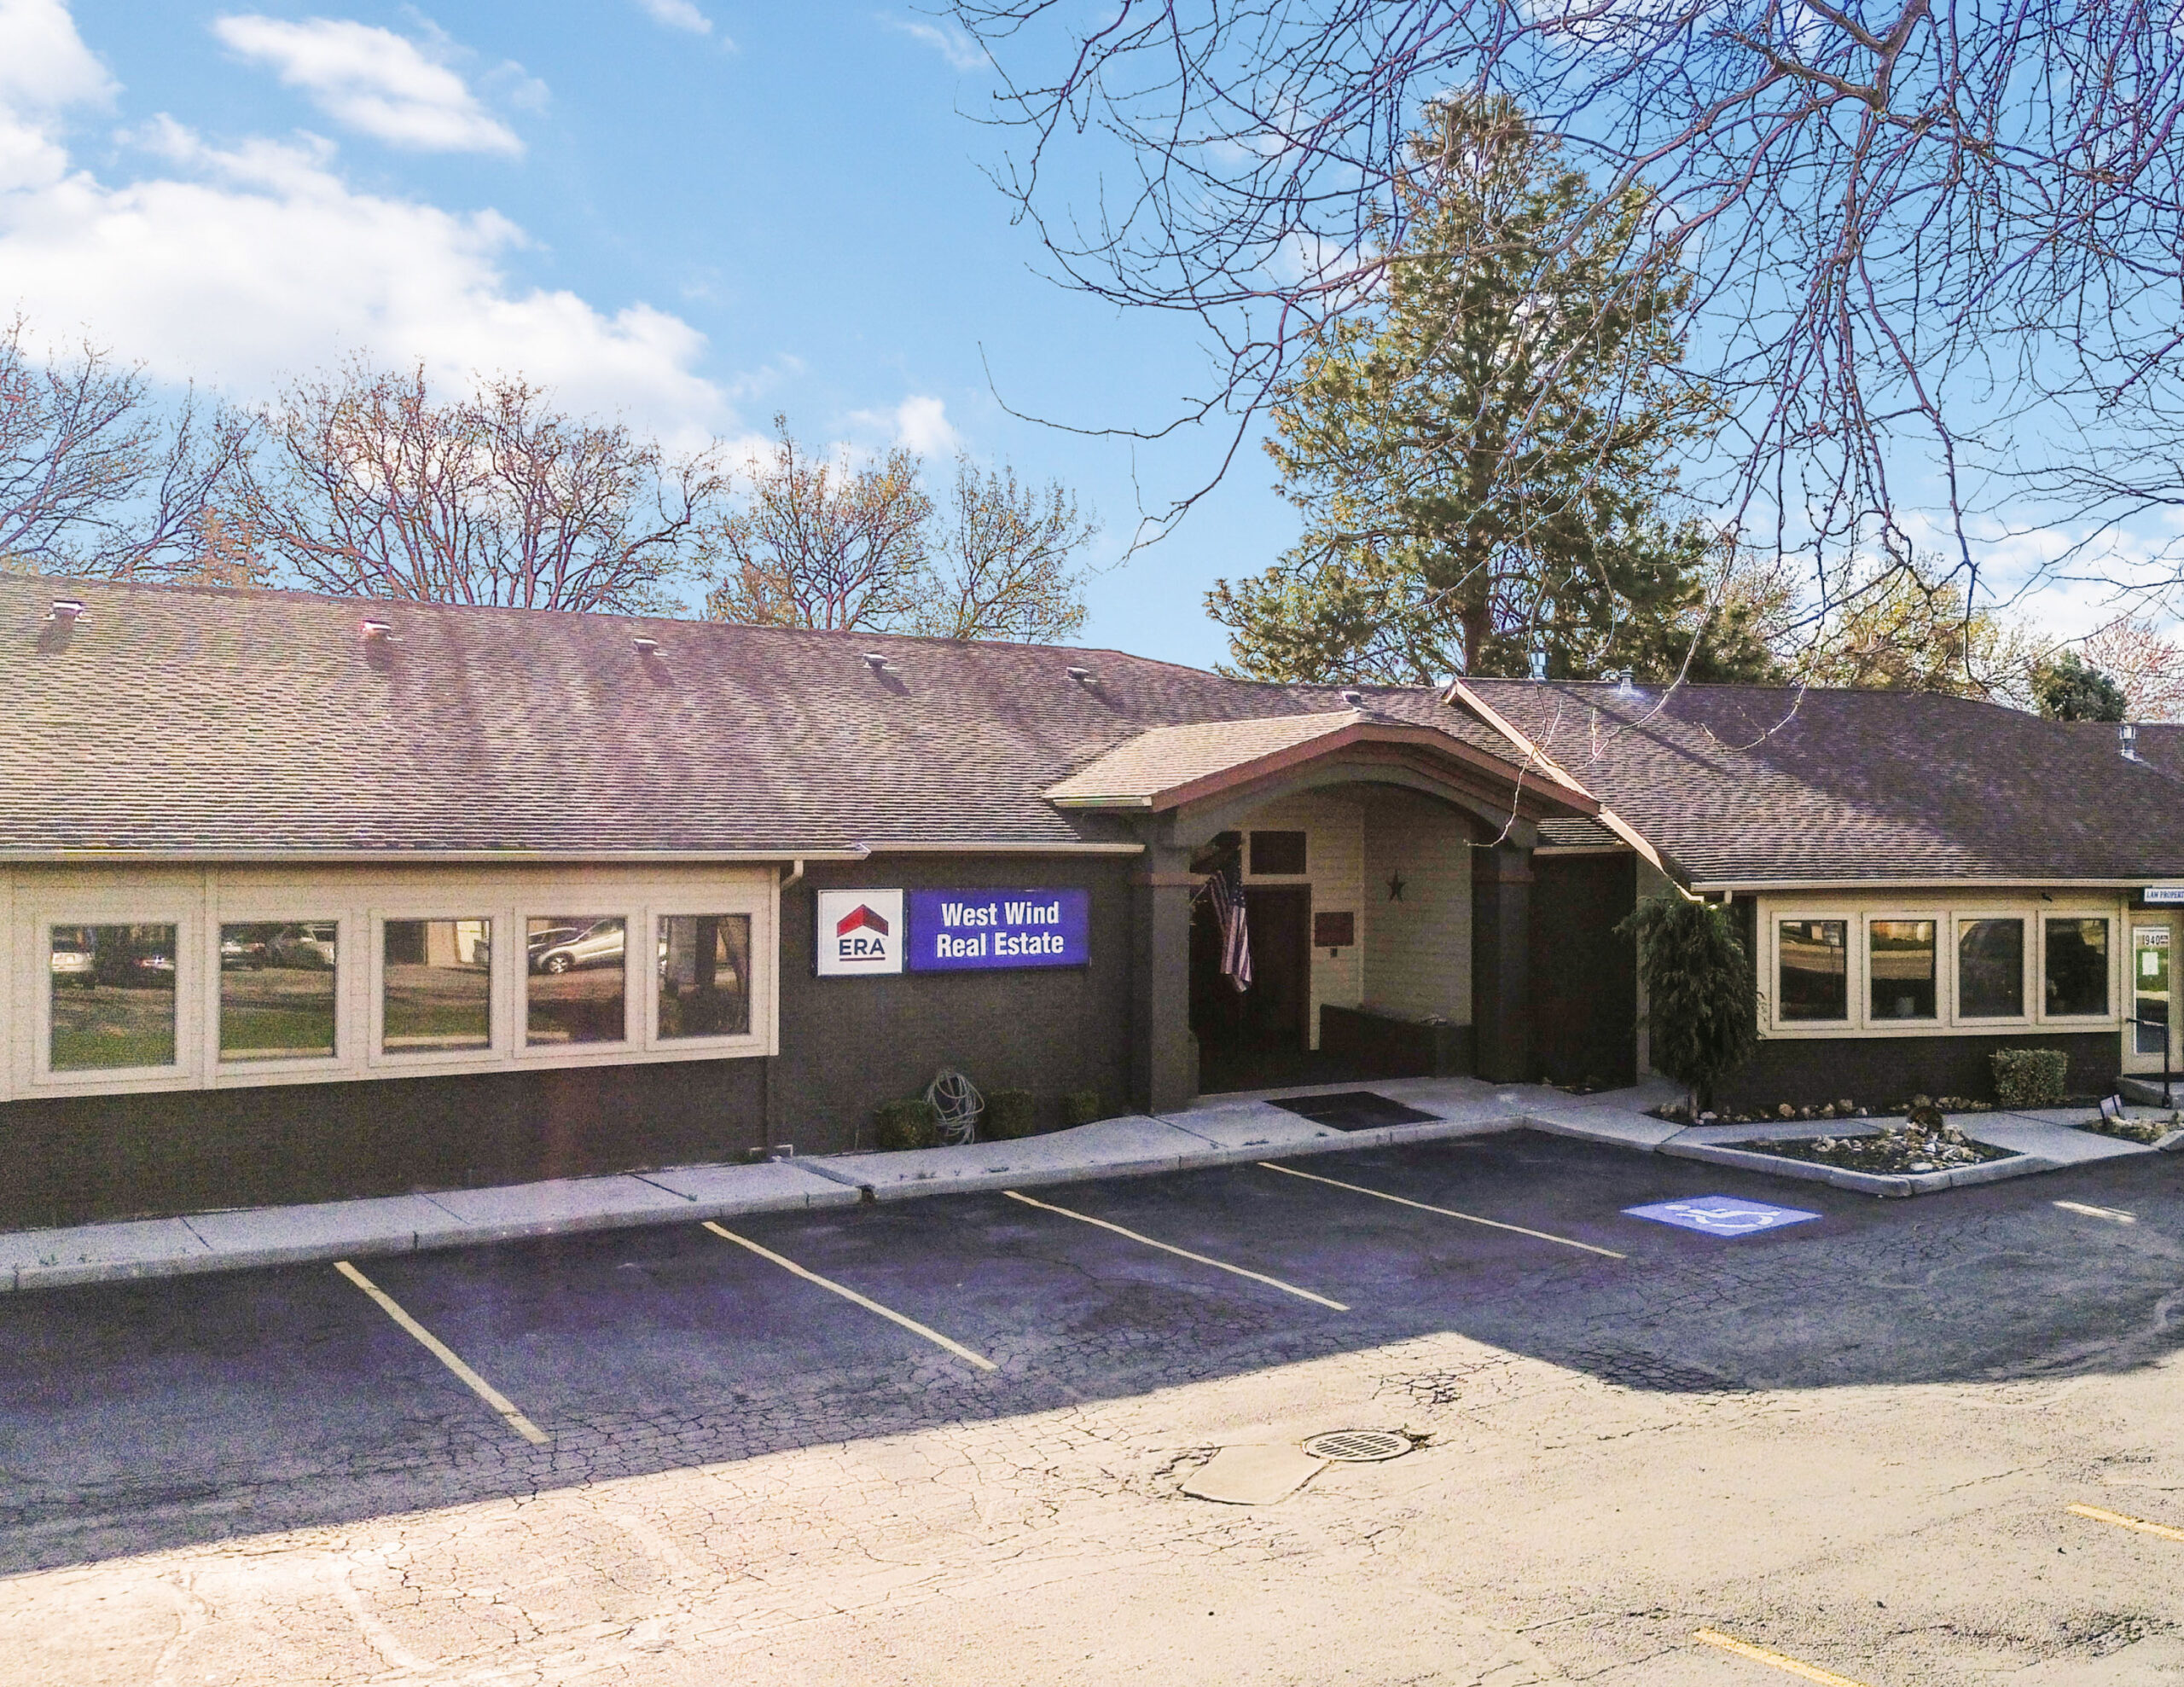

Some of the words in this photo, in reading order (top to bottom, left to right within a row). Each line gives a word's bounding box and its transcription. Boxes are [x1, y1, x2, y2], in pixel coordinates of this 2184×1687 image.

[941, 901, 997, 927] West
[1004, 901, 1060, 925] Wind
[839, 938, 886, 956] ERA
[936, 933, 986, 958] Real
[994, 931, 1065, 957] Estate
